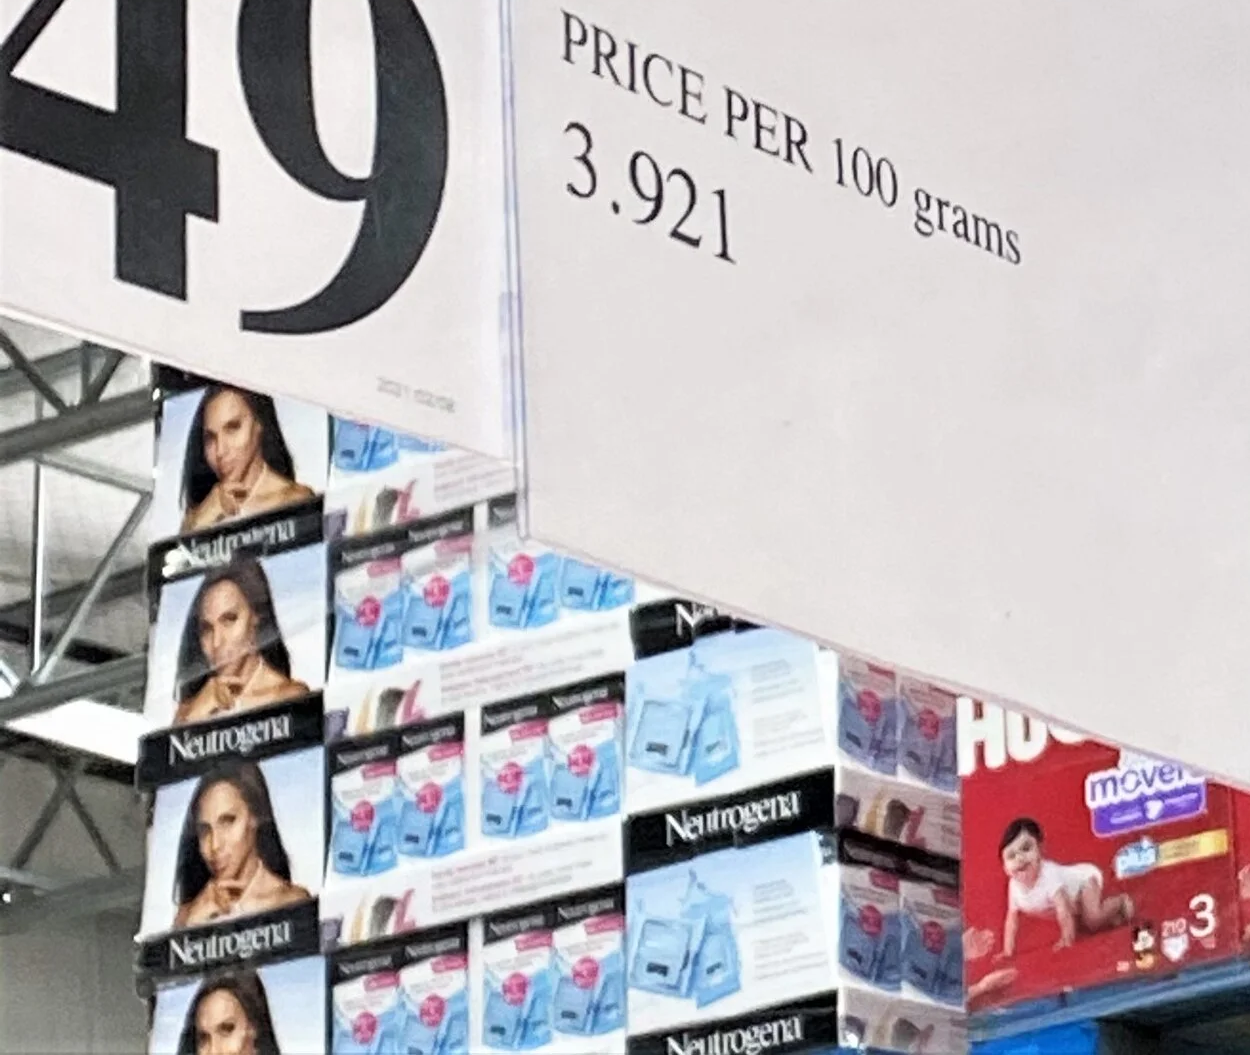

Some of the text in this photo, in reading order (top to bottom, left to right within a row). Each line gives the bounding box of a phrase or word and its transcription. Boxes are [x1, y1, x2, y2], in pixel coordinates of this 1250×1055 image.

[560, 9, 1022, 266] PRICE PER 100 grams
[564, 121, 737, 263] 3.921
[168, 711, 293, 766] Neutrogena
[956, 696, 1085, 777] HU
[665, 790, 800, 847] Neutrogena
[1188, 893, 1216, 938] 3
[168, 919, 293, 971] Neutrogena
